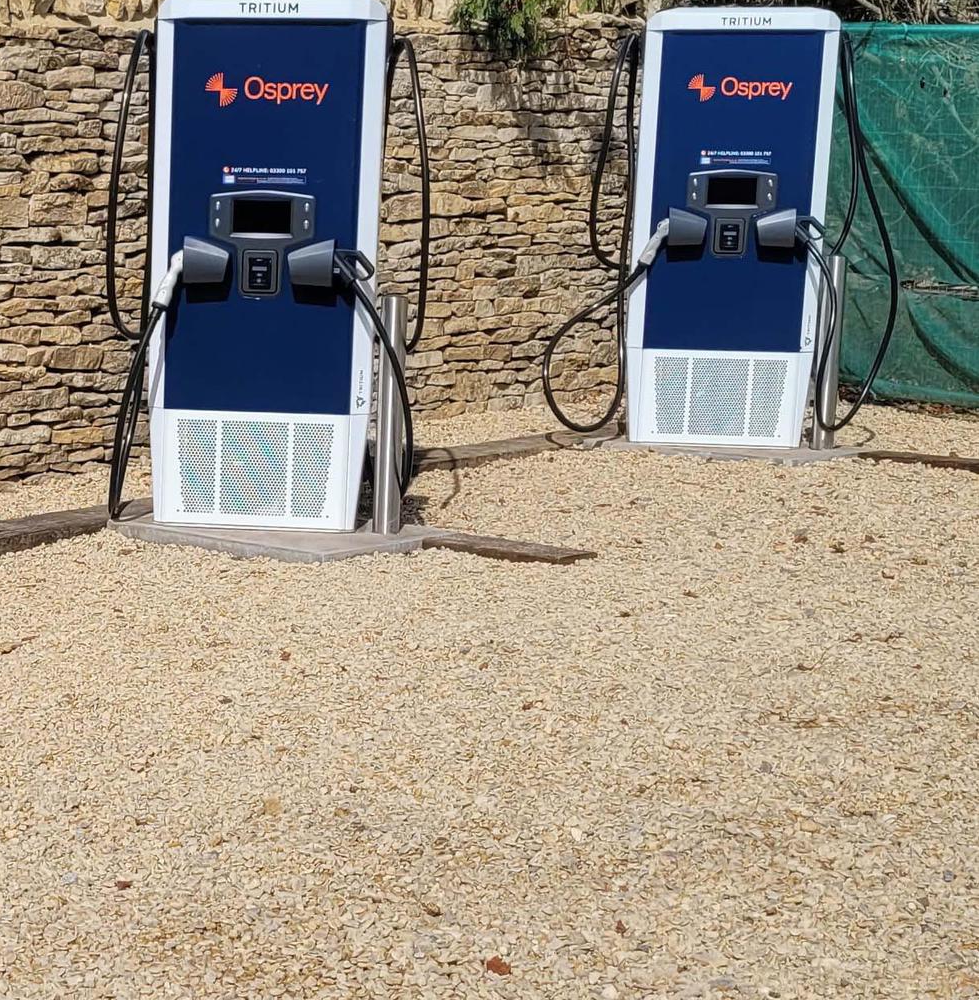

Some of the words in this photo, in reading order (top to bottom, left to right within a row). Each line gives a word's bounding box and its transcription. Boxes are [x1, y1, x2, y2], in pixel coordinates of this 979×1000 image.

[239, 2, 299, 14] TRITIUM
[722, 17, 772, 26] TRITIUM
[244, 76, 329, 105] Osprey
[721, 76, 793, 101] Osprey
